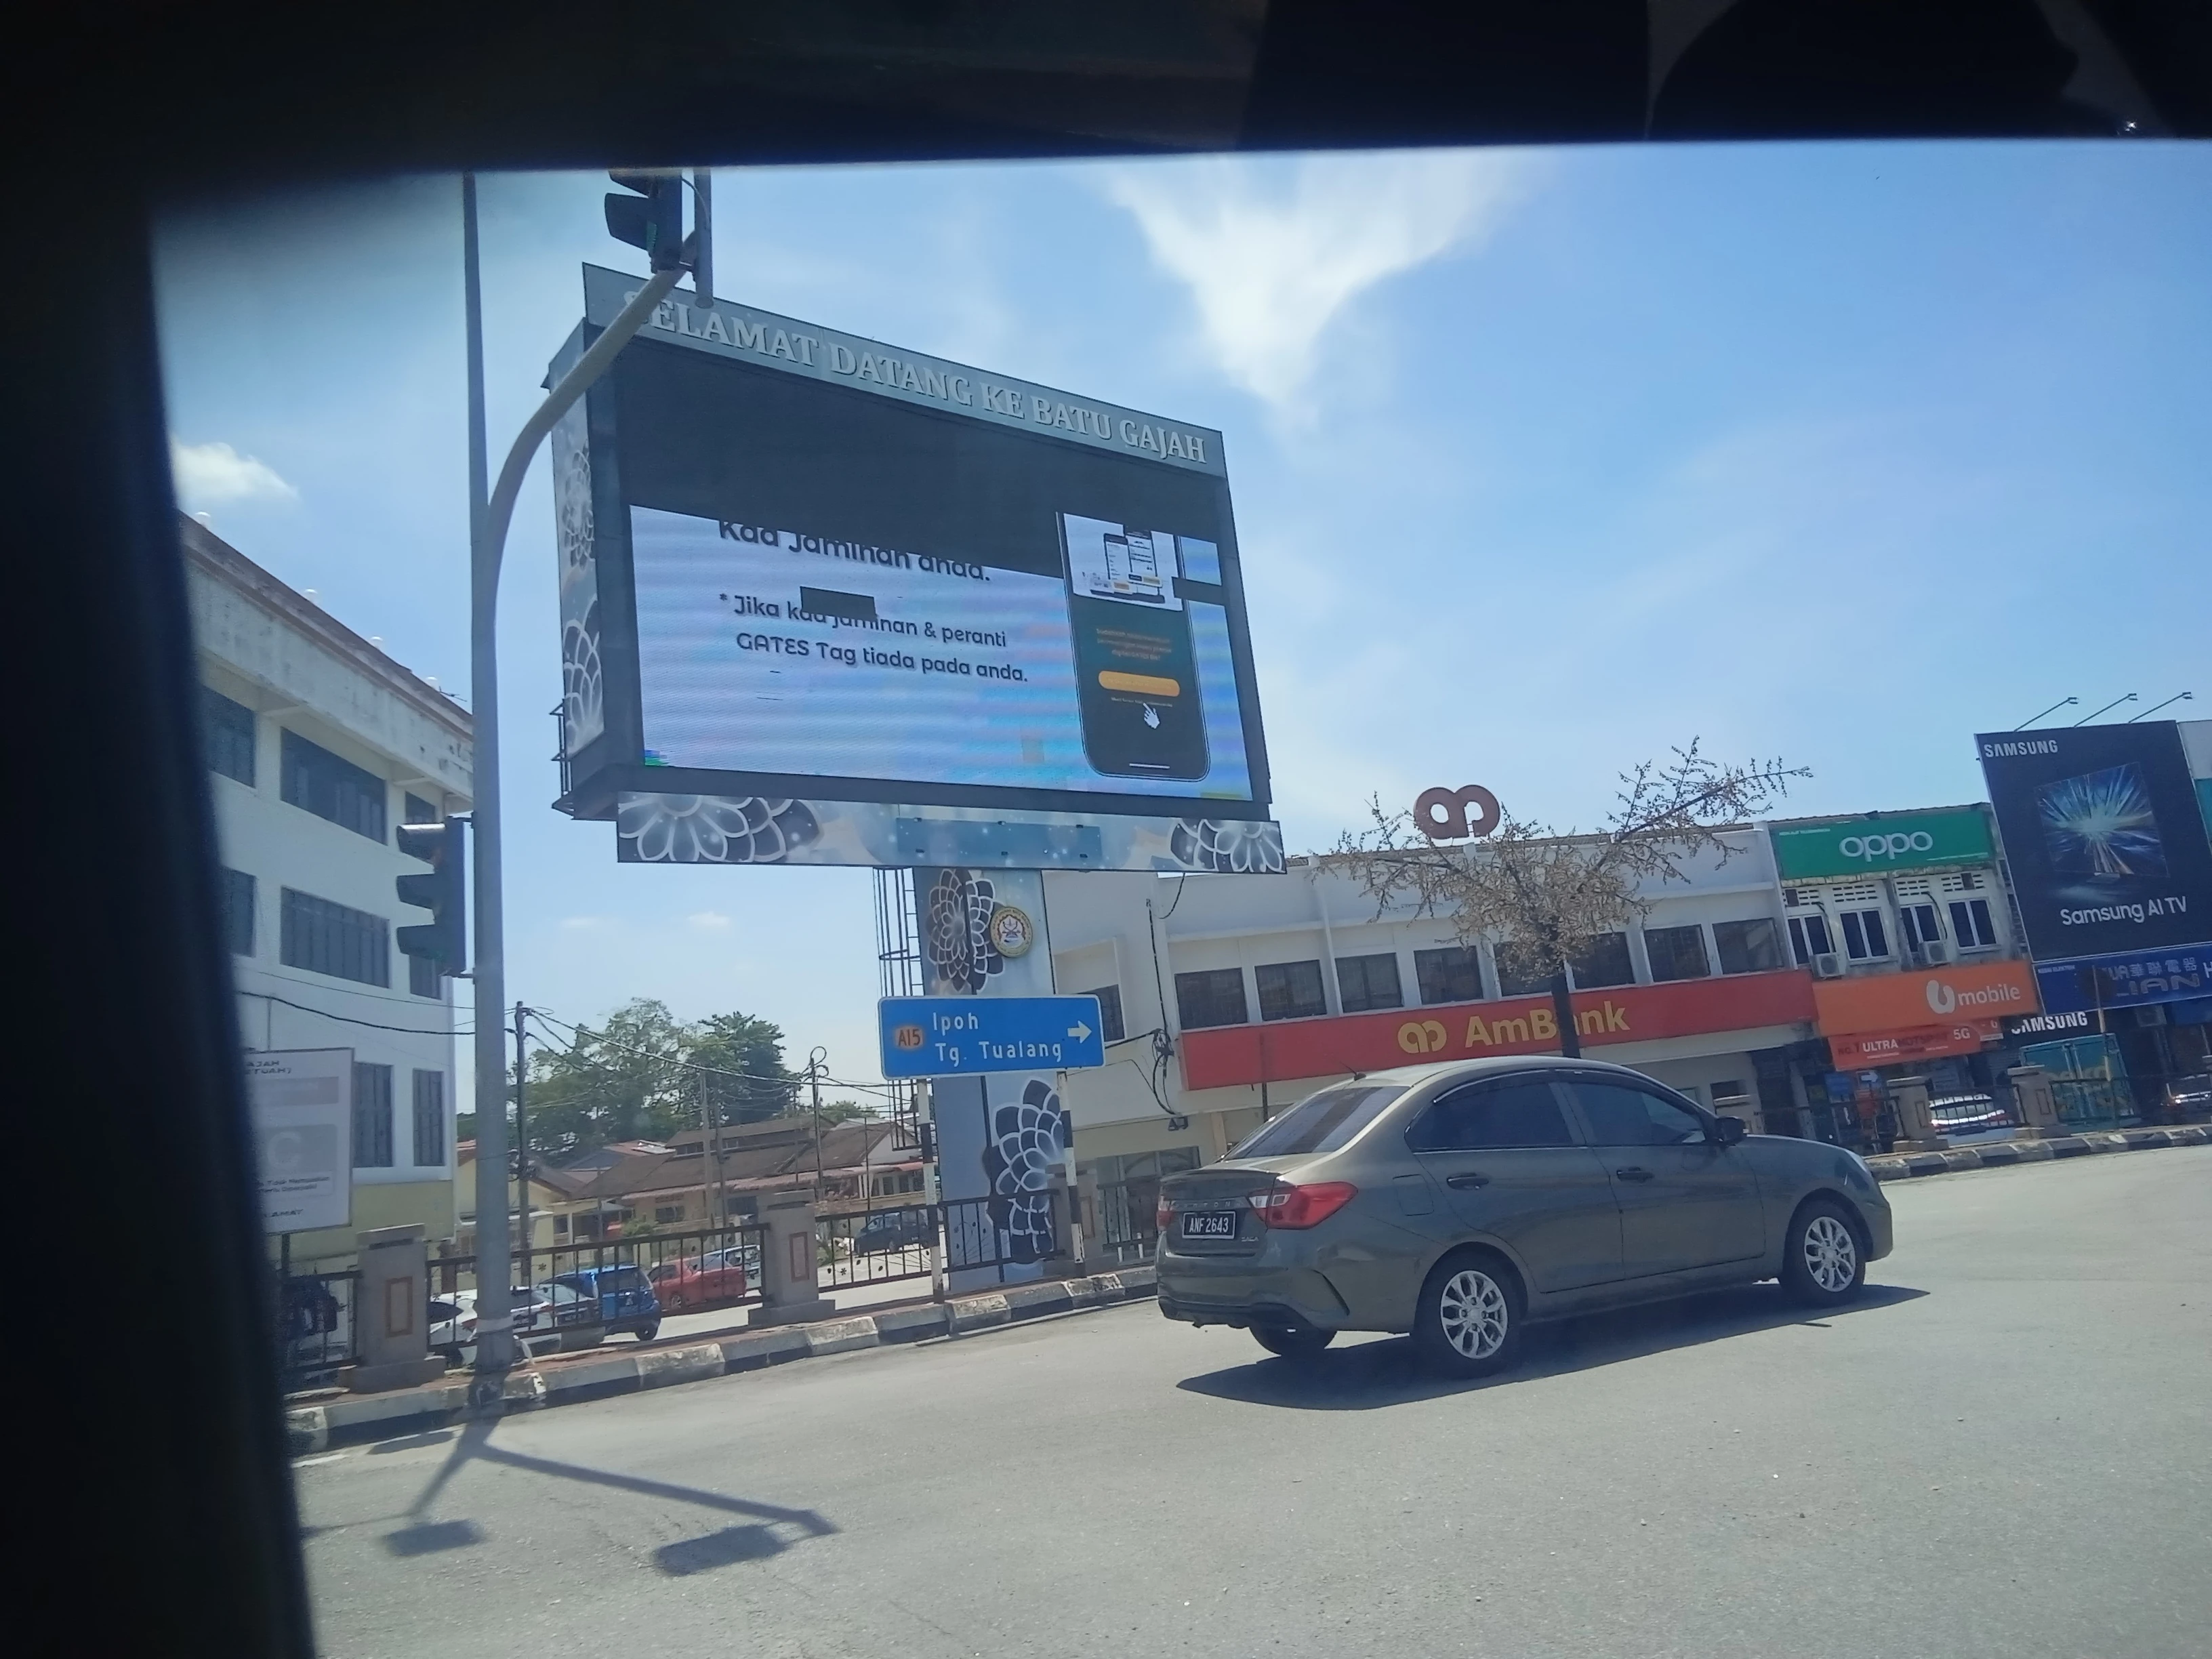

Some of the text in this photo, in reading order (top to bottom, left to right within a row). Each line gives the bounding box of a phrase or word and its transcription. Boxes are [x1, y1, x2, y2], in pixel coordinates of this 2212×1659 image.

[828, 342, 972, 407] DATANG
[980, 382, 1025, 419] KE
[1031, 395, 1112, 440] BATU
[1120, 419, 1207, 464] GAJAH
[733, 595, 779, 618] Jika
[924, 621, 937, 639] &
[941, 626, 1007, 647] peranti
[736, 632, 1028, 682] GATES Tag tiada pada anda.
[1984, 739, 2058, 758] SAMSUNG
[1839, 831, 1933, 862] oppo
[2060, 896, 2187, 926] Samsung AI TV
[1958, 983, 2021, 1006] mobile
[2116, 973, 2200, 997] IAN
[933, 1012, 979, 1036] Ipoh
[1465, 1001, 1630, 1048] AmBnk
[898, 1028, 921, 1046] A15
[1862, 1038, 1898, 1052] ULTRA
[1953, 1027, 1971, 1040] 5G
[979, 1040, 1063, 1062] Tualang
[1189, 1217, 1229, 1233] ANF 2643
